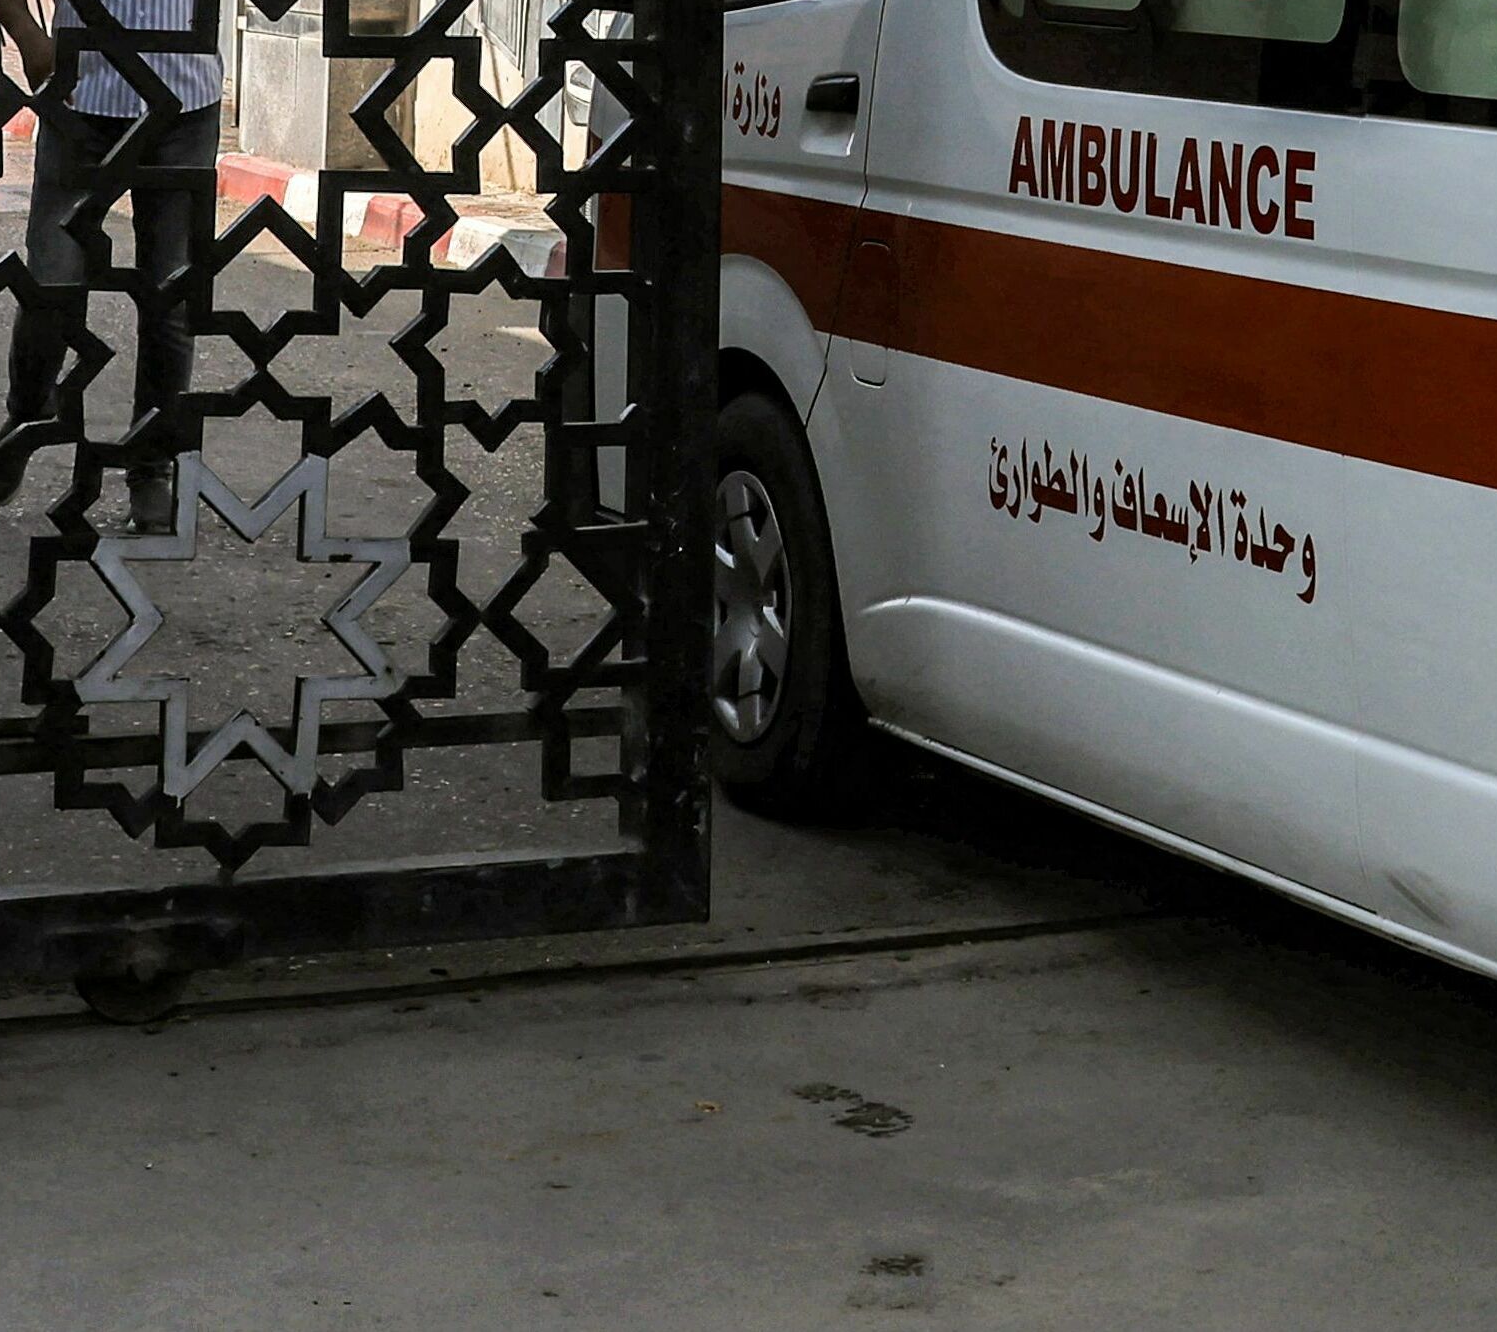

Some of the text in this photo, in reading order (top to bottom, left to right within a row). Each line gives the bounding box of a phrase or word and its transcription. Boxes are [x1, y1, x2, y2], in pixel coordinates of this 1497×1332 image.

[732, 61, 781, 139] وزارة
[1009, 116, 1316, 241] AMBULANCE
[1111, 458, 1225, 566] الإسعاف
[1230, 488, 1317, 604] وحدة
